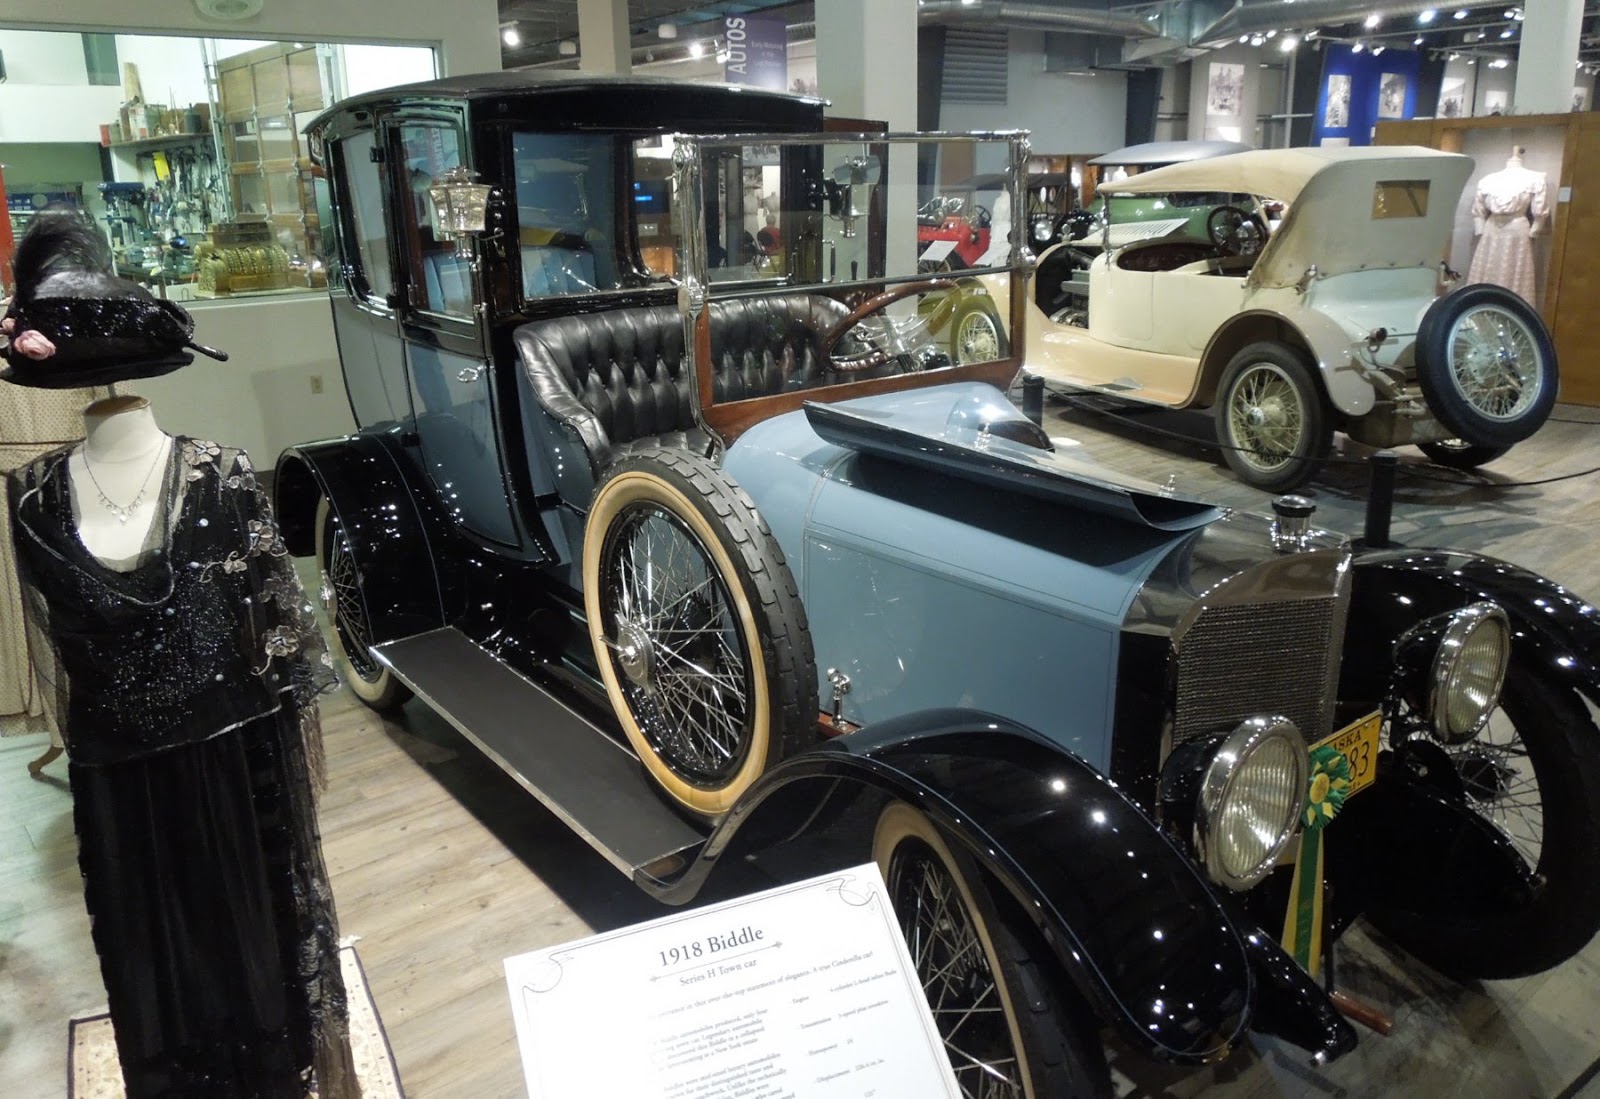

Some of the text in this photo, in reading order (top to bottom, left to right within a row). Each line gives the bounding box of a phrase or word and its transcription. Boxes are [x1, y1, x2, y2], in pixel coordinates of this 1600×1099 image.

[726, 17, 746, 74] AUTOS
[659, 926, 764, 967] 1918 Biddle
[679, 959, 757, 987] Series H Town car
